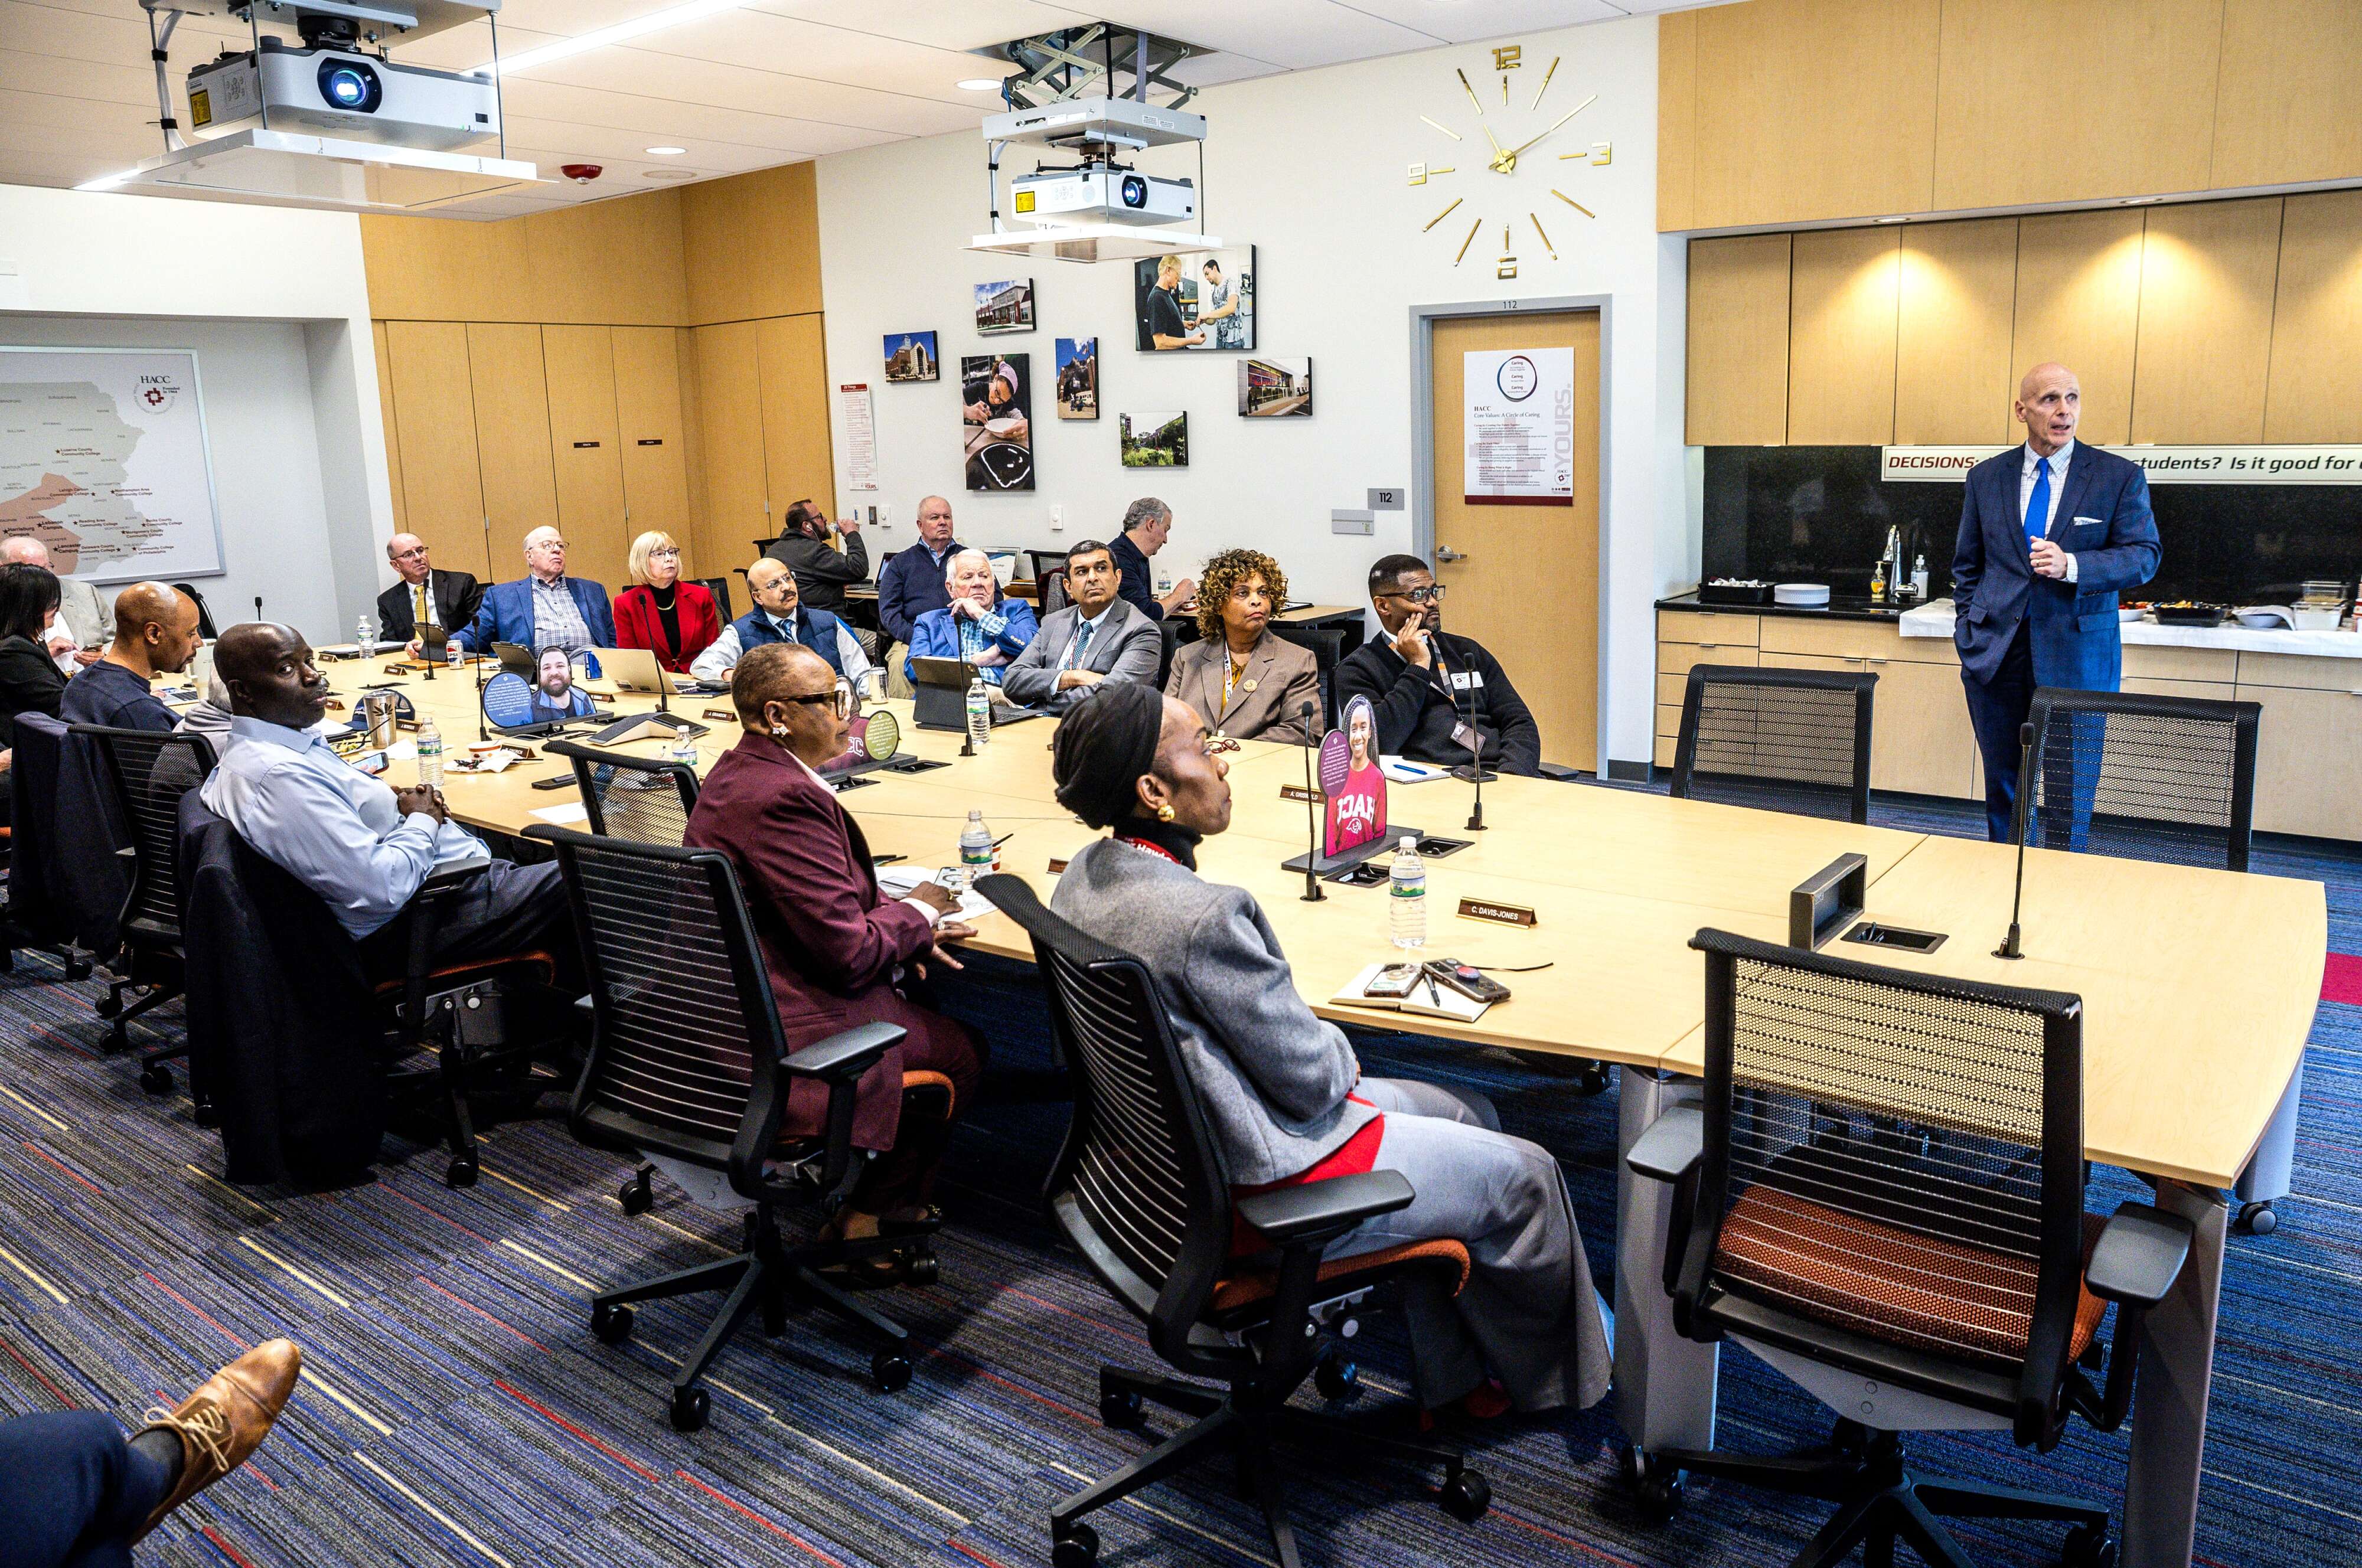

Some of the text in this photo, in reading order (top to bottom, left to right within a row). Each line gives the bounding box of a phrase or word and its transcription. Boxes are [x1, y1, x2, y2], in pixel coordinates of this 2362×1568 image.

[1492, 45, 1521, 70] 12
[1591, 142, 1611, 166] 3
[1408, 162, 1427, 185] 9
[1497, 257, 1517, 280] 6
[1503, 300, 1518, 309] 112
[141, 375, 171, 384] HACC
[2230, 457, 2247, 469] Is
[2251, 456, 2265, 469] it
[2269, 456, 2321, 473] good
[2324, 455, 2356, 470] for
[1379, 492, 1392, 502] 112
[1295, 792, 1318, 800] GRISWLD
[1479, 907, 1519, 920] DAVIS-JONES
